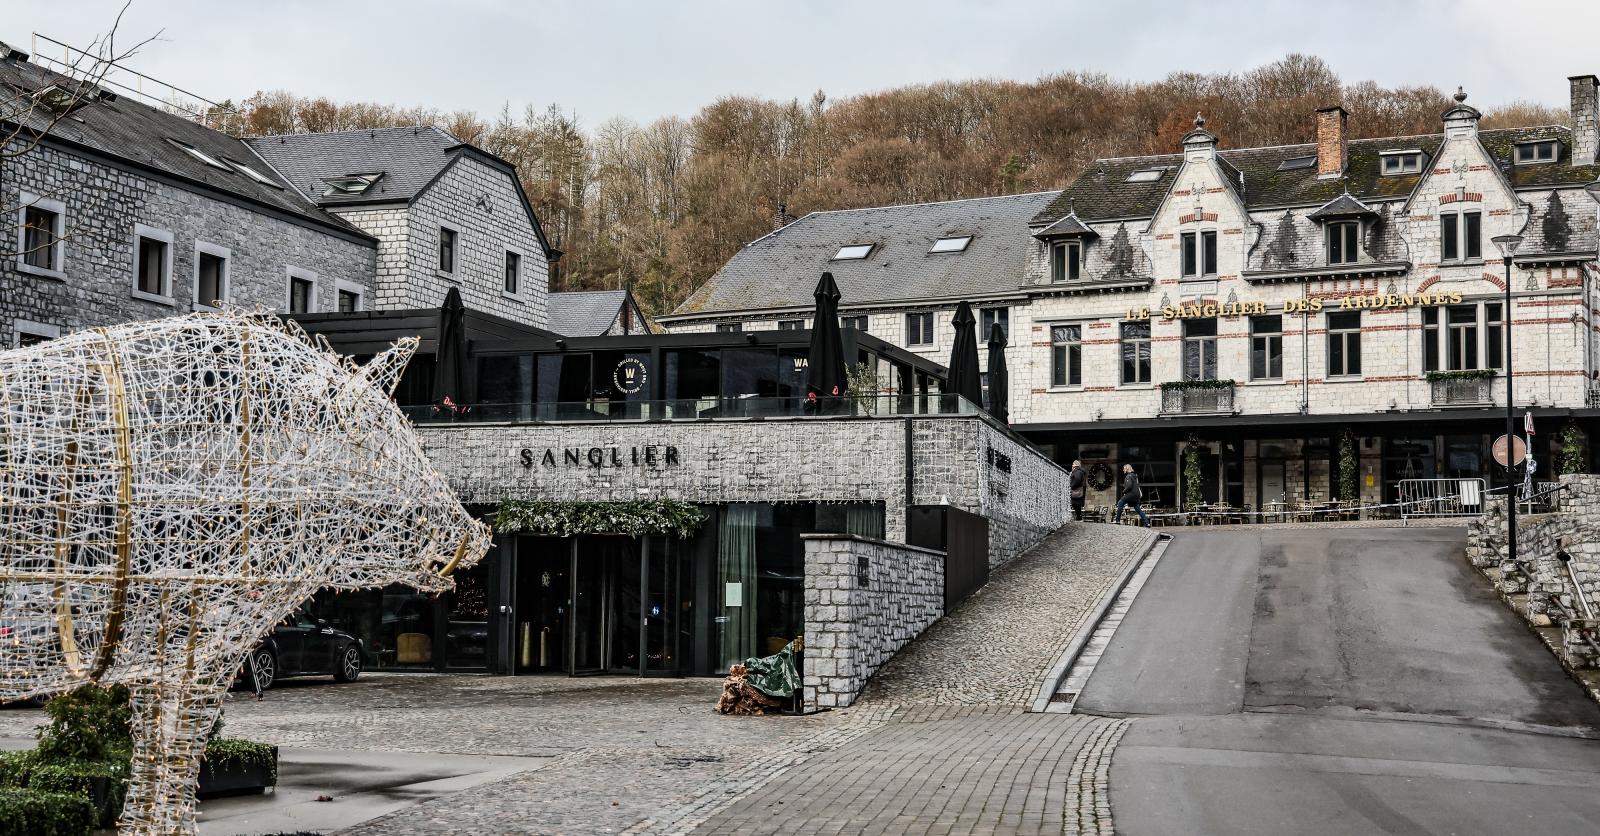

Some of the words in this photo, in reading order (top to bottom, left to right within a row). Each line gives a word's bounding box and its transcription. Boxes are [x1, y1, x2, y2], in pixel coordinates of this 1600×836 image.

[1125, 306, 1150, 321] LE
[1163, 300, 1267, 320] SANGLIER
[1283, 297, 1323, 314] DES
[1340, 291, 1463, 310] ARDENNES
[625, 368, 635, 379] W
[520, 446, 679, 468] SANGLIER
